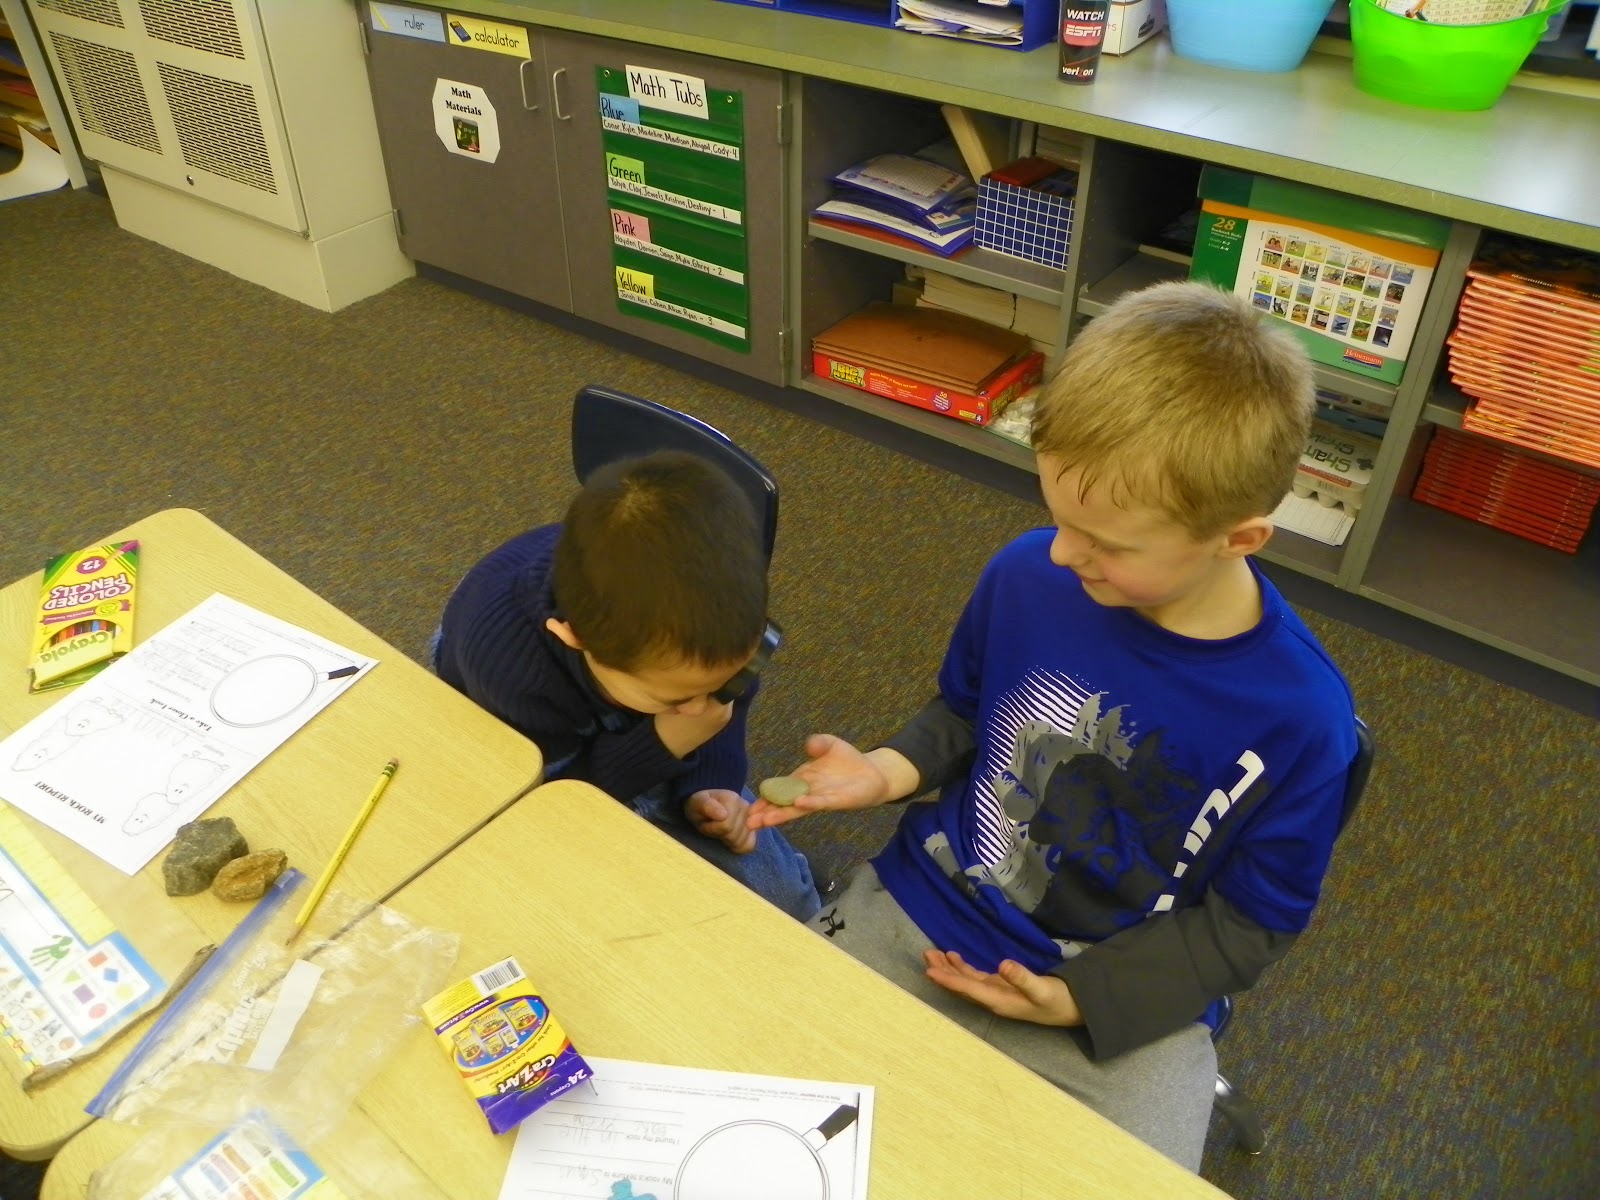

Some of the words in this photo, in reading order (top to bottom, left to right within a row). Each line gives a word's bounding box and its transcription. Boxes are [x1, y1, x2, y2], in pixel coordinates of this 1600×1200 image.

[1067, 9, 1105, 20] WATCH
[404, 15, 425, 31] ruler
[1066, 24, 1101, 37] ESPN
[475, 28, 519, 48] calculator
[1062, 66, 1094, 78] verizon
[451, 87, 472, 100] Math
[630, 72, 666, 98] Math
[670, 78, 704, 107] Tubs
[445, 100, 482, 116] Materials
[601, 97, 625, 122] Blue
[610, 157, 642, 184] Green
[614, 212, 636, 237] Pink
[1212, 217, 1236, 231] 28
[618, 271, 646, 295] Yellow
[1345, 349, 1383, 364] Heinemann
[837, 362, 859, 376] BIG
[832, 370, 863, 386] MONEY
[82, 559, 101, 571] 12
[52, 574, 127, 598] PENCILS
[44, 584, 132, 610] COLORED
[40, 631, 109, 663] Crayola
[150, 697, 168, 709] Look
[167, 706, 189, 720] Closer
[34, 779, 69, 803] REPORT
[68, 799, 93, 817] ROCK
[92, 813, 106, 825] MY
[568, 1069, 588, 1086] 24
[550, 1083, 571, 1096] Crayons
[643, 1135, 653, 1143] my
